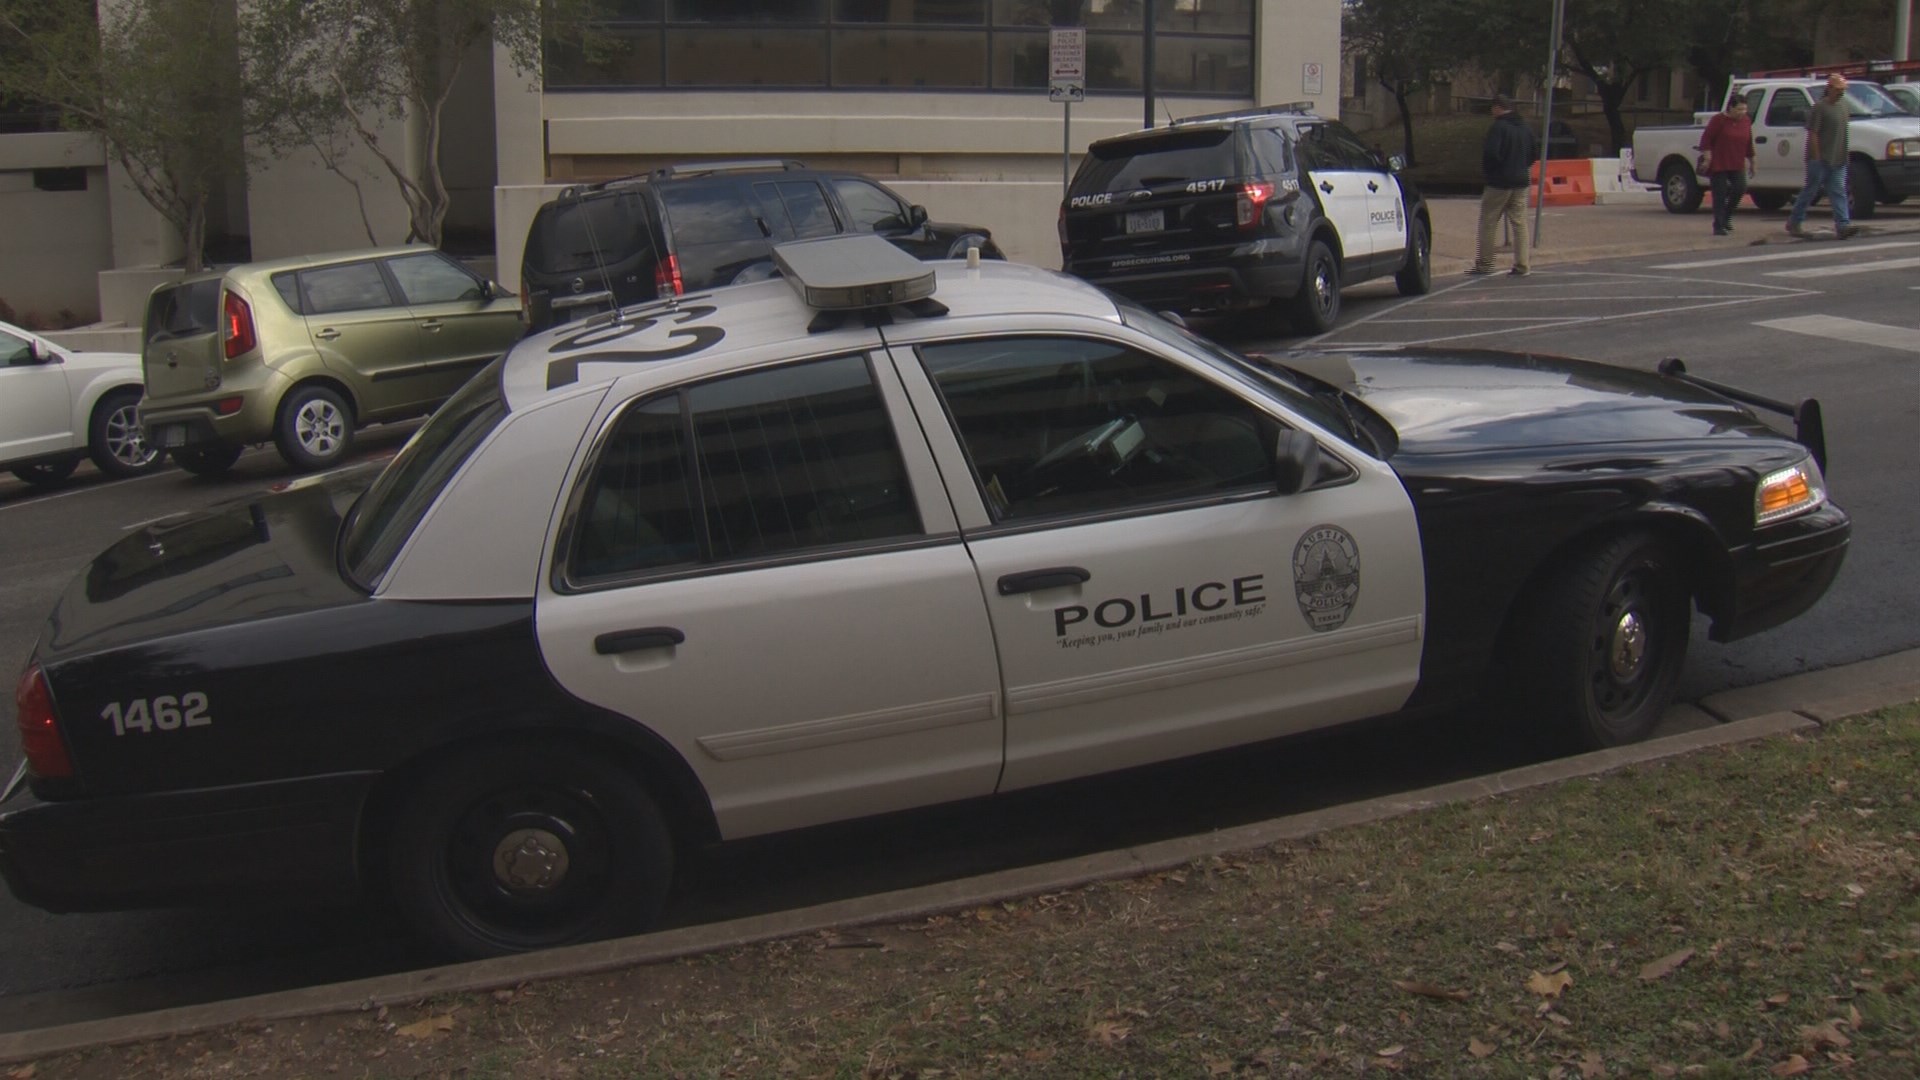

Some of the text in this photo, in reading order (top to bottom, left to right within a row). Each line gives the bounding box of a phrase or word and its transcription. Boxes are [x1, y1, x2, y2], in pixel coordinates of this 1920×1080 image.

[1186, 179, 1225, 193] 4517
[1071, 193, 1112, 208] POLICE
[1371, 210, 1395, 221] POLICE
[1302, 530, 1346, 552] AUSTIN
[1054, 574, 1266, 637] POLICE
[1310, 591, 1349, 608] POLICE
[1097, 632, 1115, 645] you,
[1117, 629, 1136, 642] your
[1137, 622, 1164, 638] family
[1166, 618, 1181, 630] and
[1183, 618, 1197, 628] our
[1199, 609, 1243, 624] community
[100, 691, 212, 736] 1462
